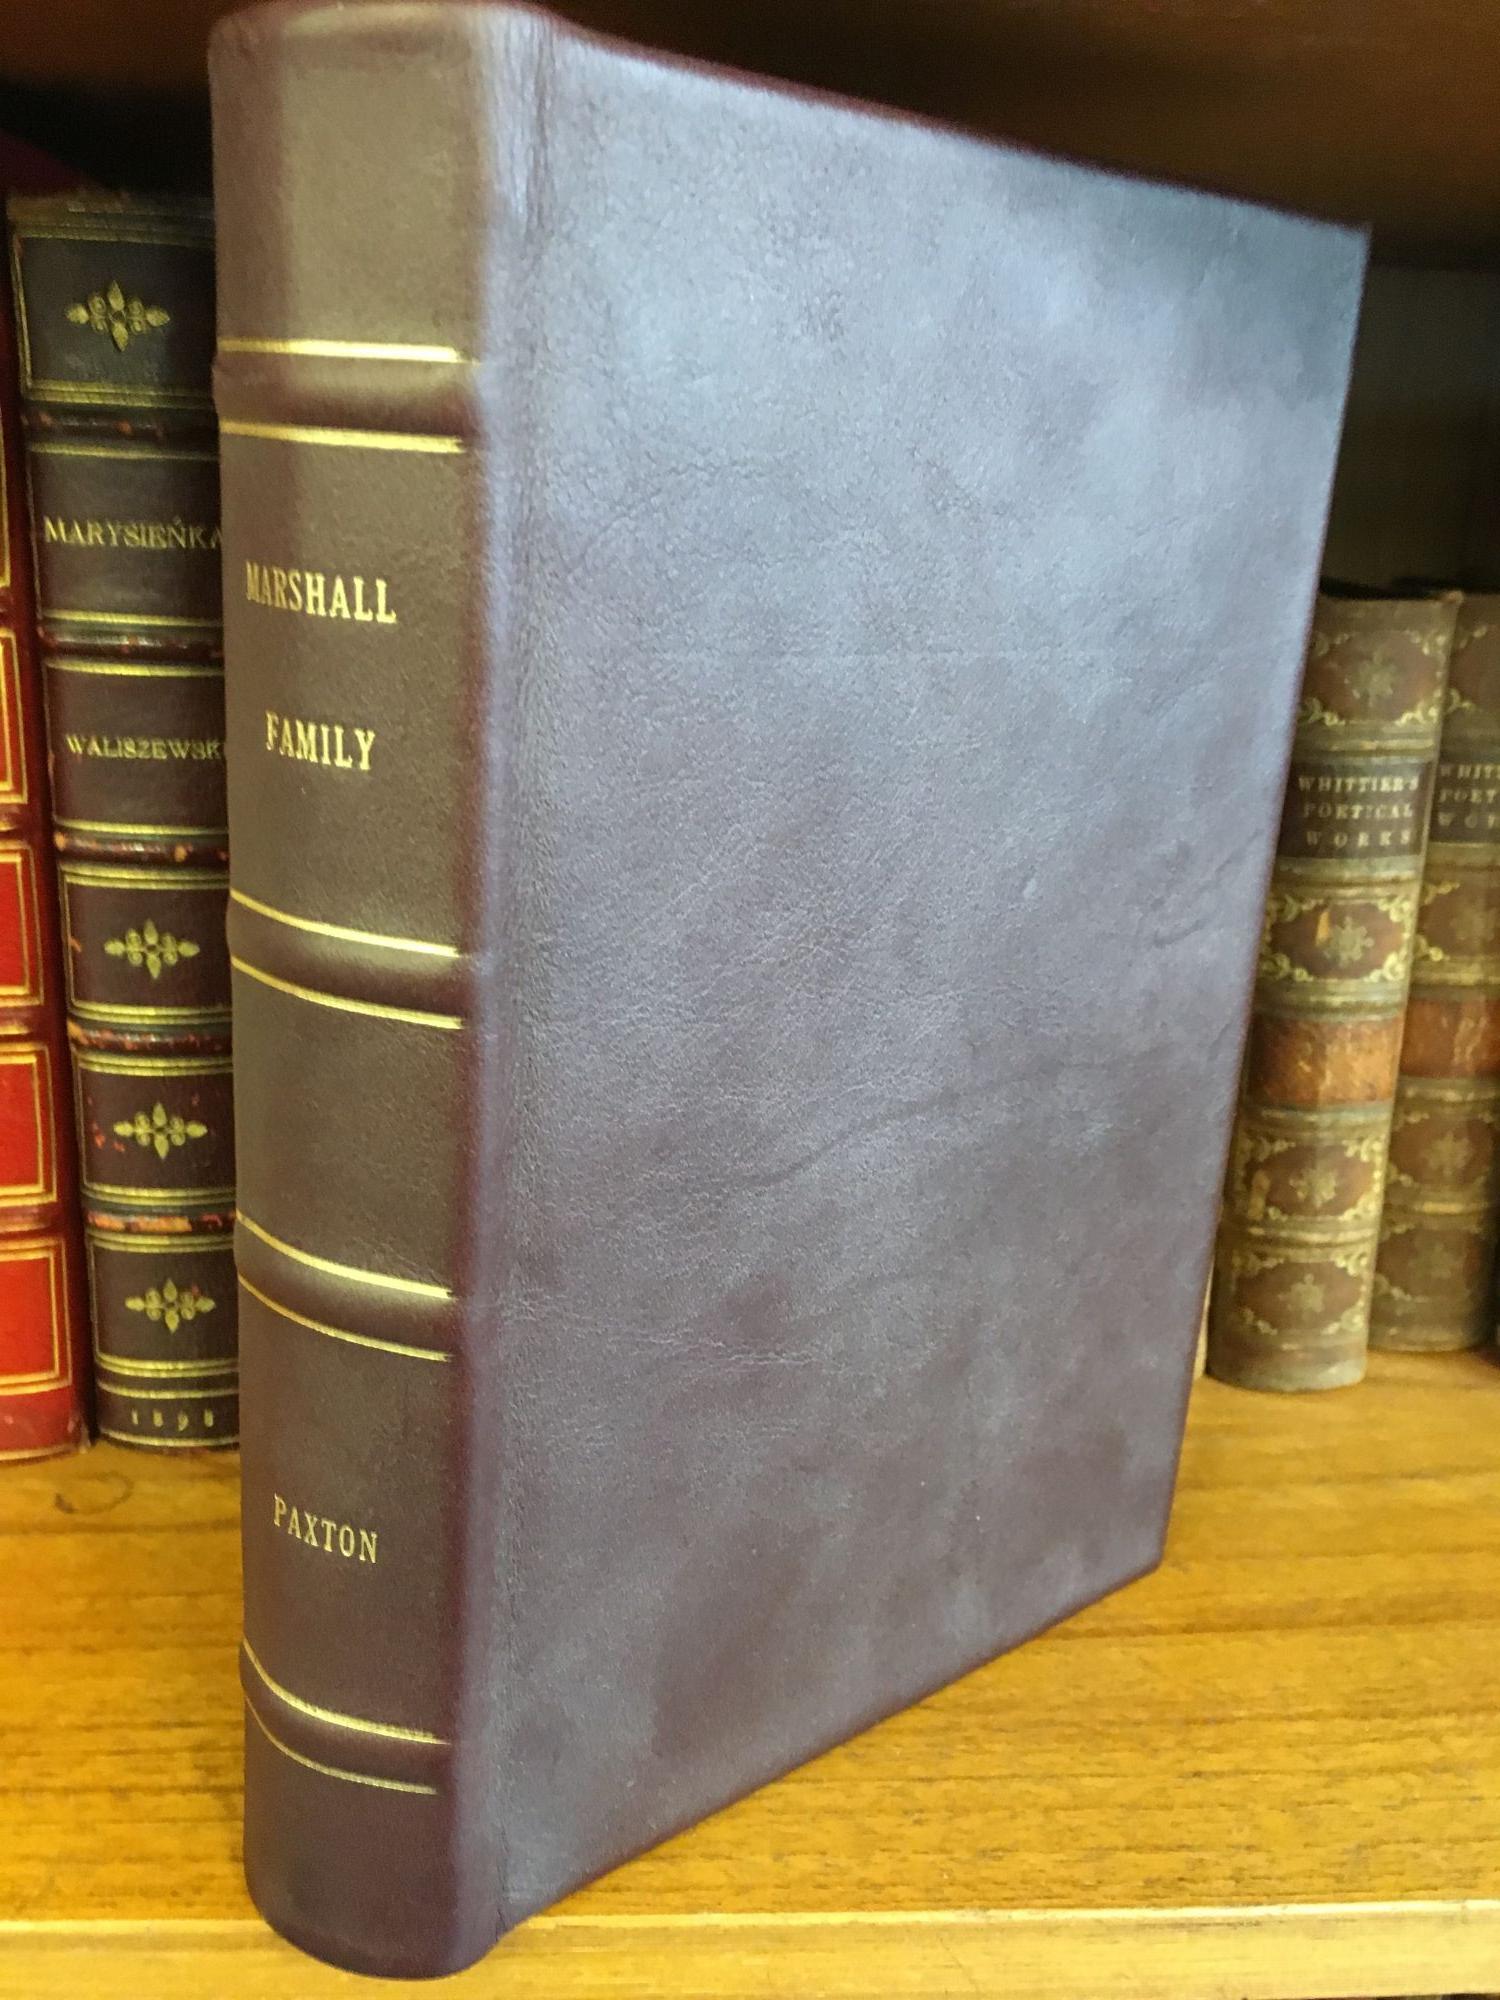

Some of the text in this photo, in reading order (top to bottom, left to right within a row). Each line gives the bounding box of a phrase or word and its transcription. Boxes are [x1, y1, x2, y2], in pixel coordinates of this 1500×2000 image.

[246, 560, 397, 624] MARSHALL
[65, 734, 222, 760] WALISZEWSK
[265, 711, 376, 771] FAMILY
[274, 1493, 378, 1564] PAXTON
